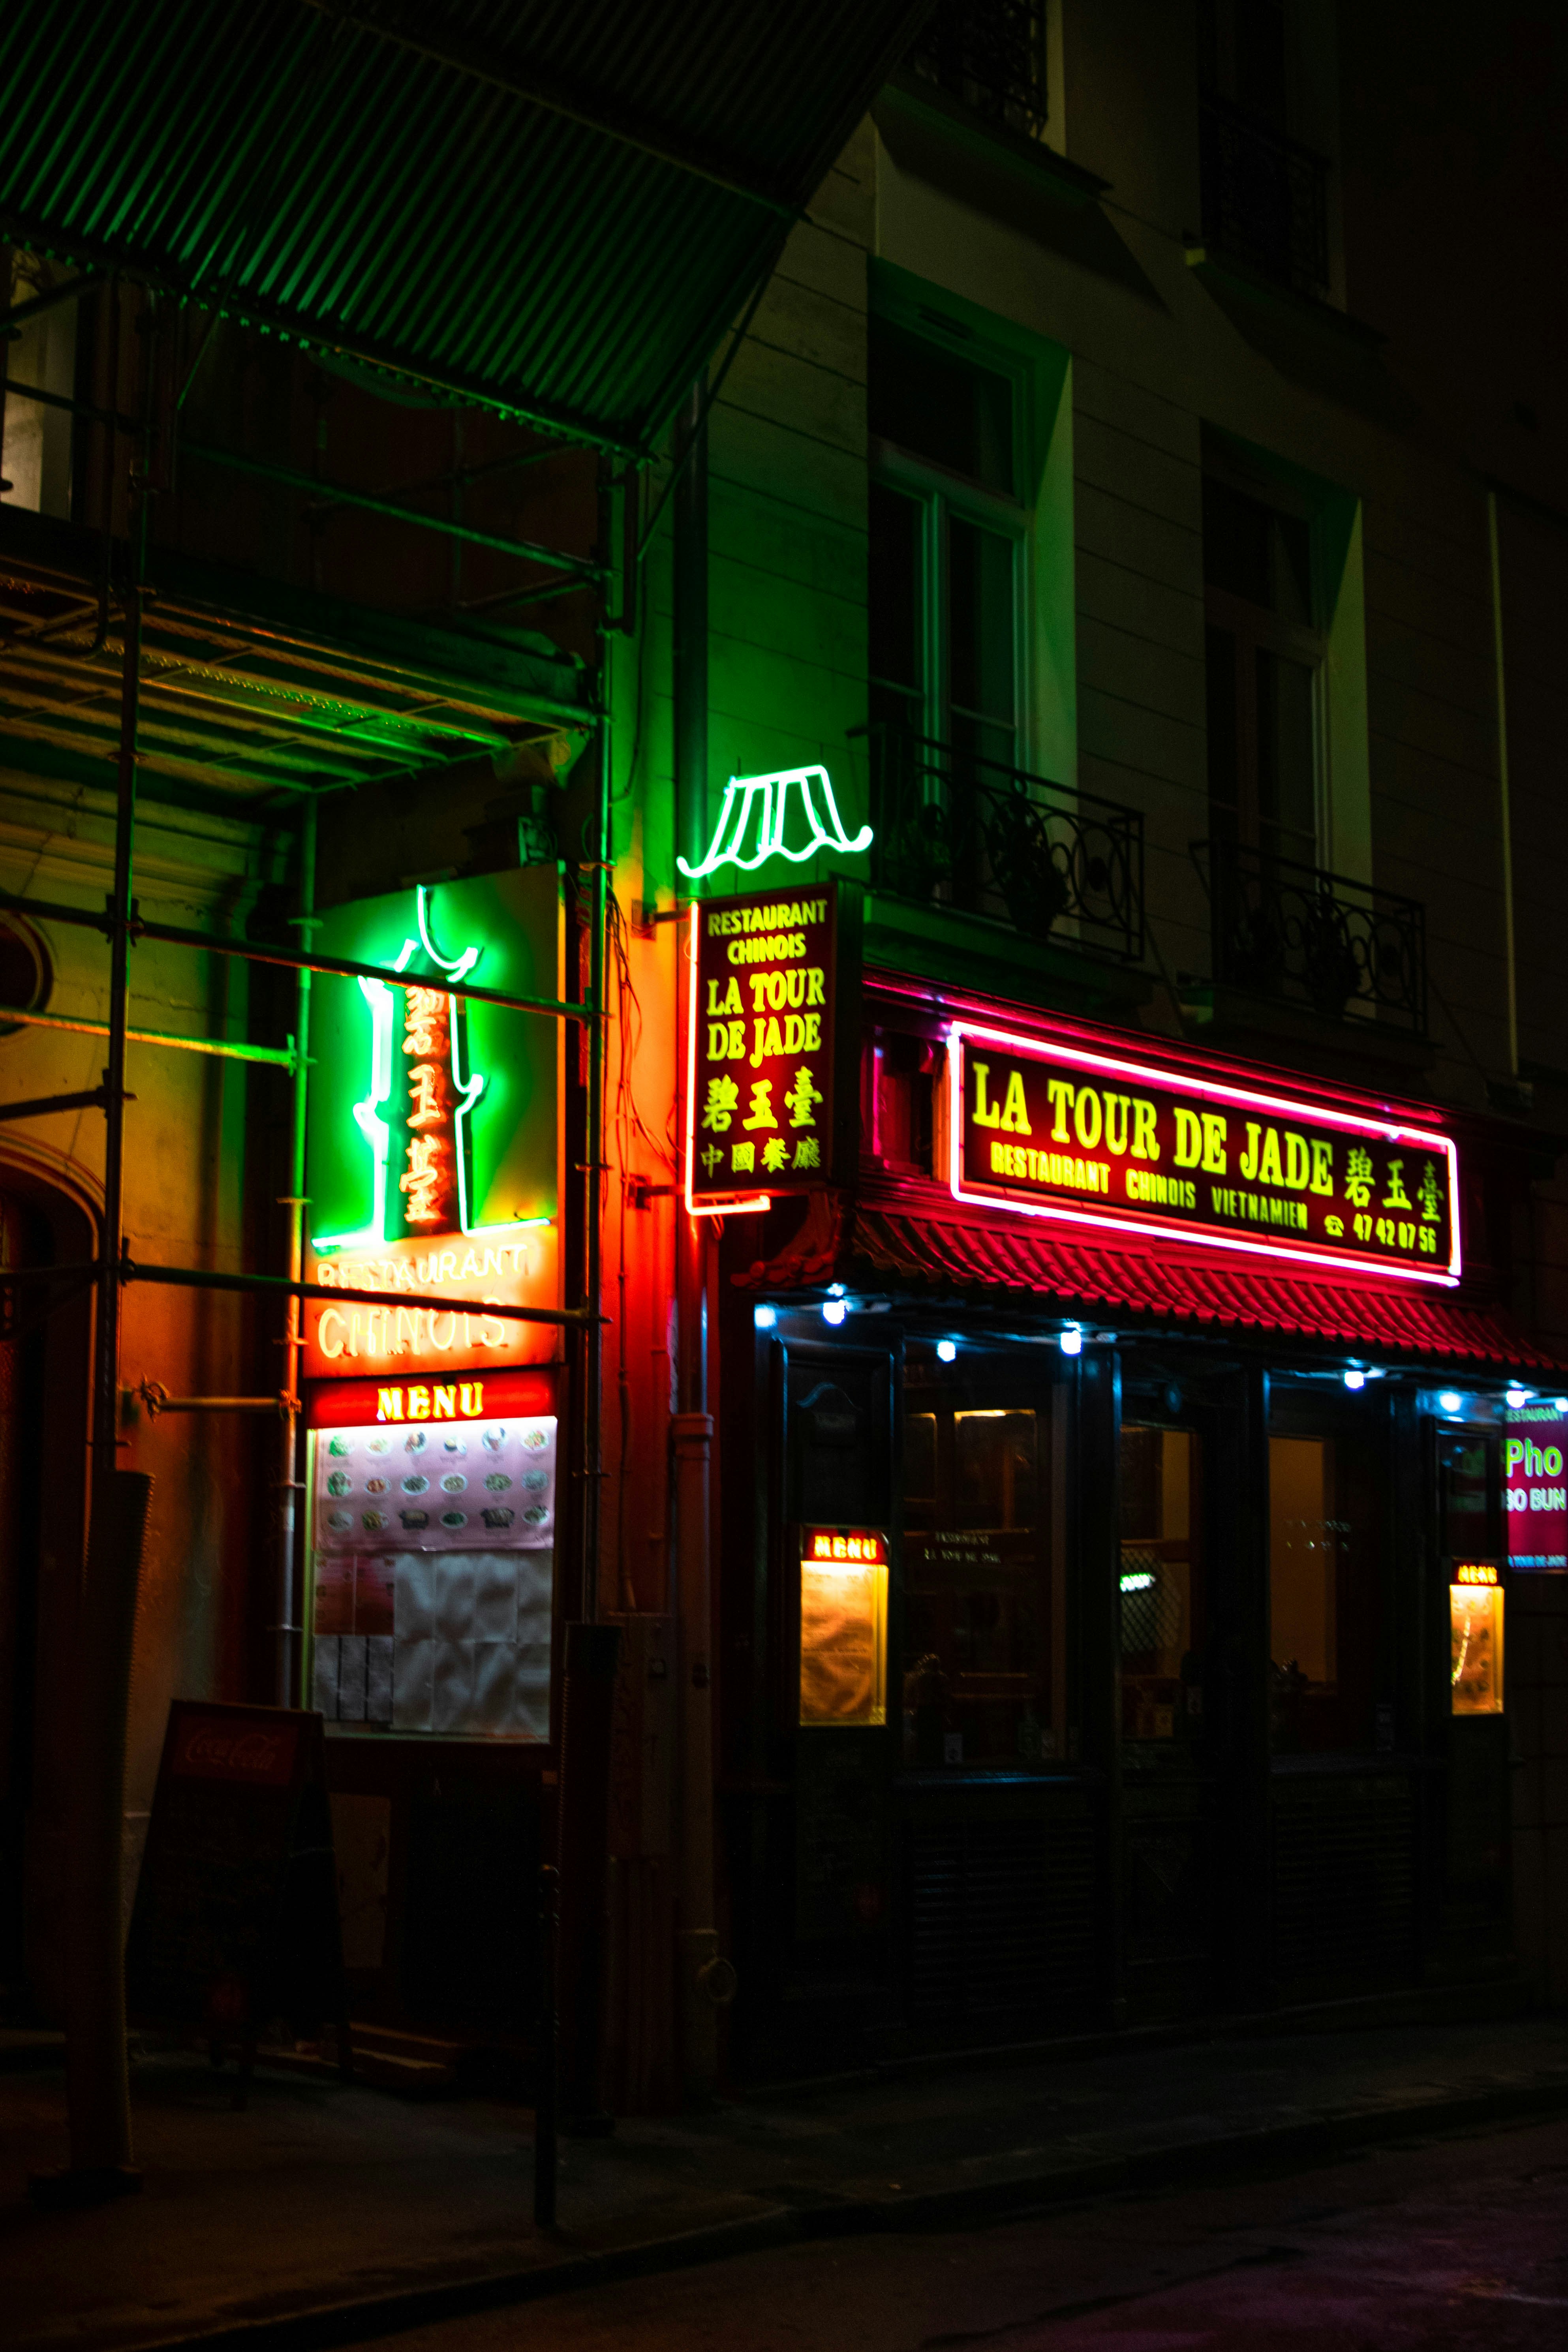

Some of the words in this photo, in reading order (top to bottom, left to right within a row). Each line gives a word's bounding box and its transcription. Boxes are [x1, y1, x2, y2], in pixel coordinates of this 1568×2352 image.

[708, 899, 827, 937] RESTAURANT
[727, 932, 806, 965] CHINOIS
[706, 976, 744, 1016] LA
[749, 967, 826, 1010] TOUR
[706, 1020, 746, 1061] DE
[749, 1012, 821, 1068] JADE
[972, 1061, 1032, 1135] LA
[1047, 1078, 1160, 1161] TOUR
[1174, 1107, 1226, 1175] DE
[1239, 1121, 1333, 1196] JADE
[990, 1141, 1110, 1193] RESTAURANT
[1126, 1168, 1196, 1209] CHINOIS
[1211, 1186, 1307, 1230] VIETNAMIEN
[1353, 1213, 1373, 1241] 47
[1375, 1217, 1395, 1246] 42
[1398, 1222, 1416, 1250] 07
[1419, 1225, 1436, 1254] 56
[317, 1244, 527, 1291] RESTAURANT
[319, 1294, 505, 1358] CHINOIS
[377, 1382, 483, 1420] MENU
[1505, 1437, 1563, 1477] Pho
[1529, 1488, 1566, 1511] BUN
[814, 1535, 876, 1560] MENU
